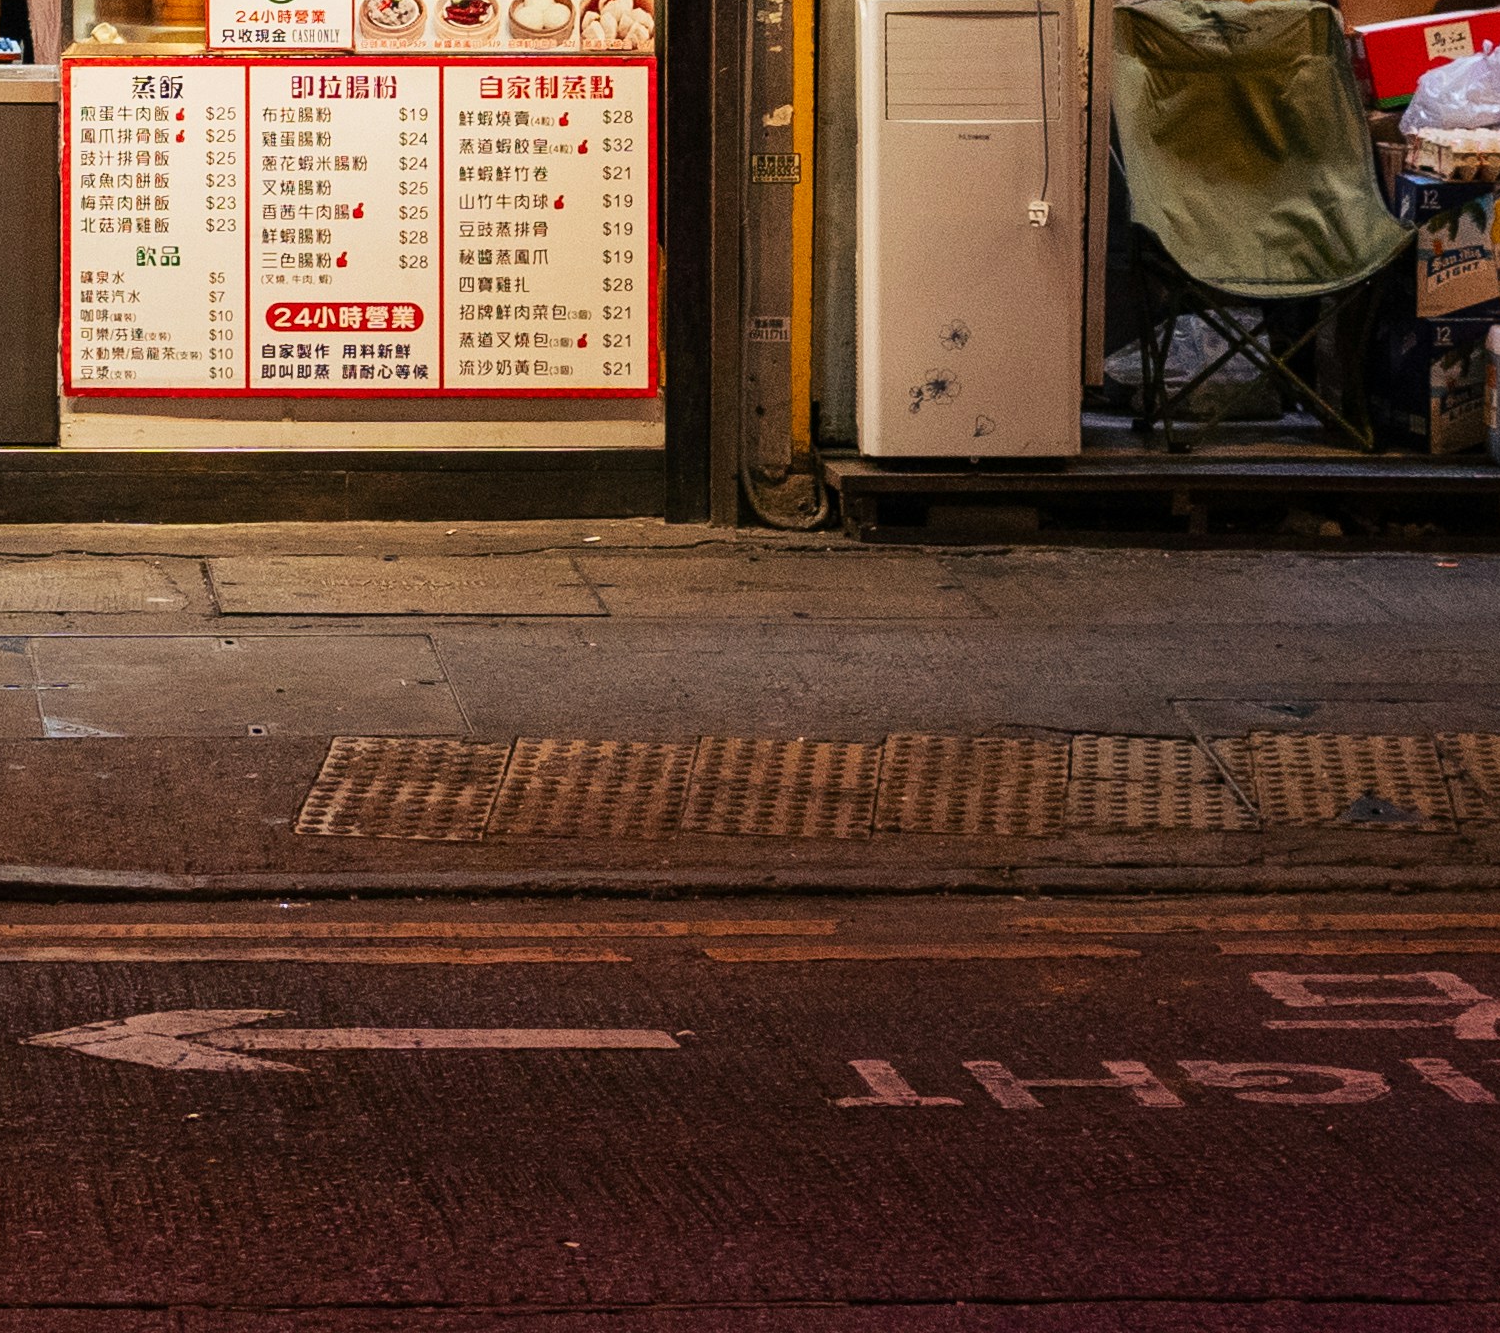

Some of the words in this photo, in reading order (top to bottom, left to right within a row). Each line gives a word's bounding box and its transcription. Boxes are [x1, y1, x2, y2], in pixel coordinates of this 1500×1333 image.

[235, 9, 327, 24] 24小時營業
[222, 29, 286, 43] 只收現金
[293, 29, 316, 43] CASH
[317, 29, 340, 43] ONLY
[132, 76, 184, 100] 蒸飯
[291, 76, 397, 100] 即拉腸粉
[479, 76, 615, 100] 自家制蒸點
[81, 107, 170, 123] 煎蛋牛肉飯
[206, 107, 237, 122] $25
[262, 107, 332, 123] 布拉腸粉
[399, 107, 429, 122] $19
[602, 110, 634, 125] $28
[206, 129, 237, 144] $25
[262, 132, 332, 148] 雞蛋腸粉
[399, 132, 429, 147] $24
[602, 138, 634, 153] $32
[206, 151, 237, 166] $25
[399, 156, 429, 171] $24
[206, 174, 237, 189] $23
[459, 166, 549, 183] 鮮蝦鮮竹卷
[602, 166, 632, 181] $21
[262, 180, 332, 196] 叉燒腸粉
[399, 180, 429, 195] $25
[81, 195, 170, 211] 梅菜肉餅飯
[206, 195, 237, 210] $23
[459, 194, 549, 211] 山竹牛肉球
[602, 194, 634, 209] $19
[1421, 190, 1440, 206] 12
[399, 205, 429, 220] $25
[206, 218, 237, 233] $23
[459, 222, 549, 239] 豆豉蒸排骨
[602, 222, 634, 237] $19
[262, 229, 332, 245] 鮮蝦腸粉
[399, 229, 429, 244] $28
[136, 246, 181, 267] 飲品
[262, 253, 332, 269] 三色腸粉
[399, 253, 429, 268] $28
[602, 250, 634, 265] $19
[1435, 259, 1482, 284] LIGHT
[602, 277, 634, 292] $28
[274, 305, 416, 330] 24小時營業
[602, 304, 632, 319] $21
[602, 332, 632, 347] $21
[261, 344, 330, 360] 自家製作
[342, 344, 411, 360] 用料新鮮
[261, 364, 330, 380] 即叫即蒸
[342, 364, 429, 380] 請耐心等候
[602, 360, 632, 375] $21
